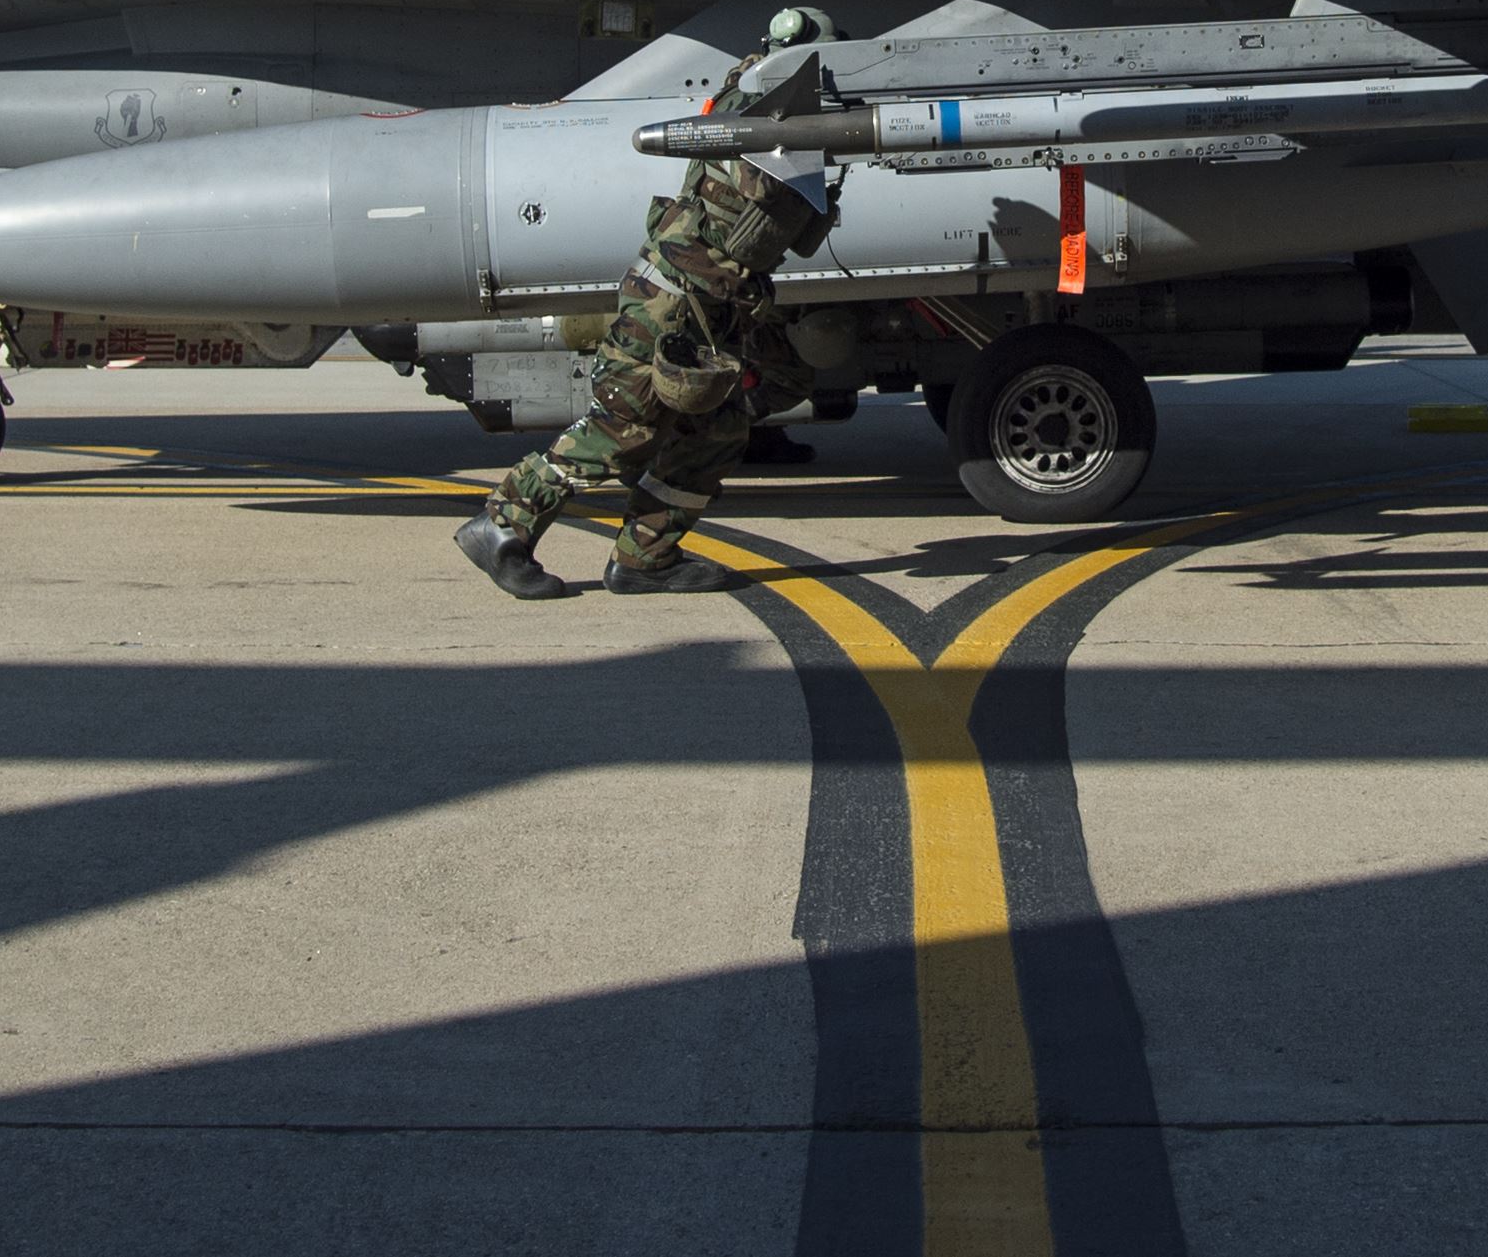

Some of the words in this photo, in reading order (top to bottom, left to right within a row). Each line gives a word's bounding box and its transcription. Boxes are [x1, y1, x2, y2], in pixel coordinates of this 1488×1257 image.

[1065, 171, 1080, 222] BEFORE
[944, 228, 974, 241] LIFT
[1065, 223, 1081, 277] LOADING
